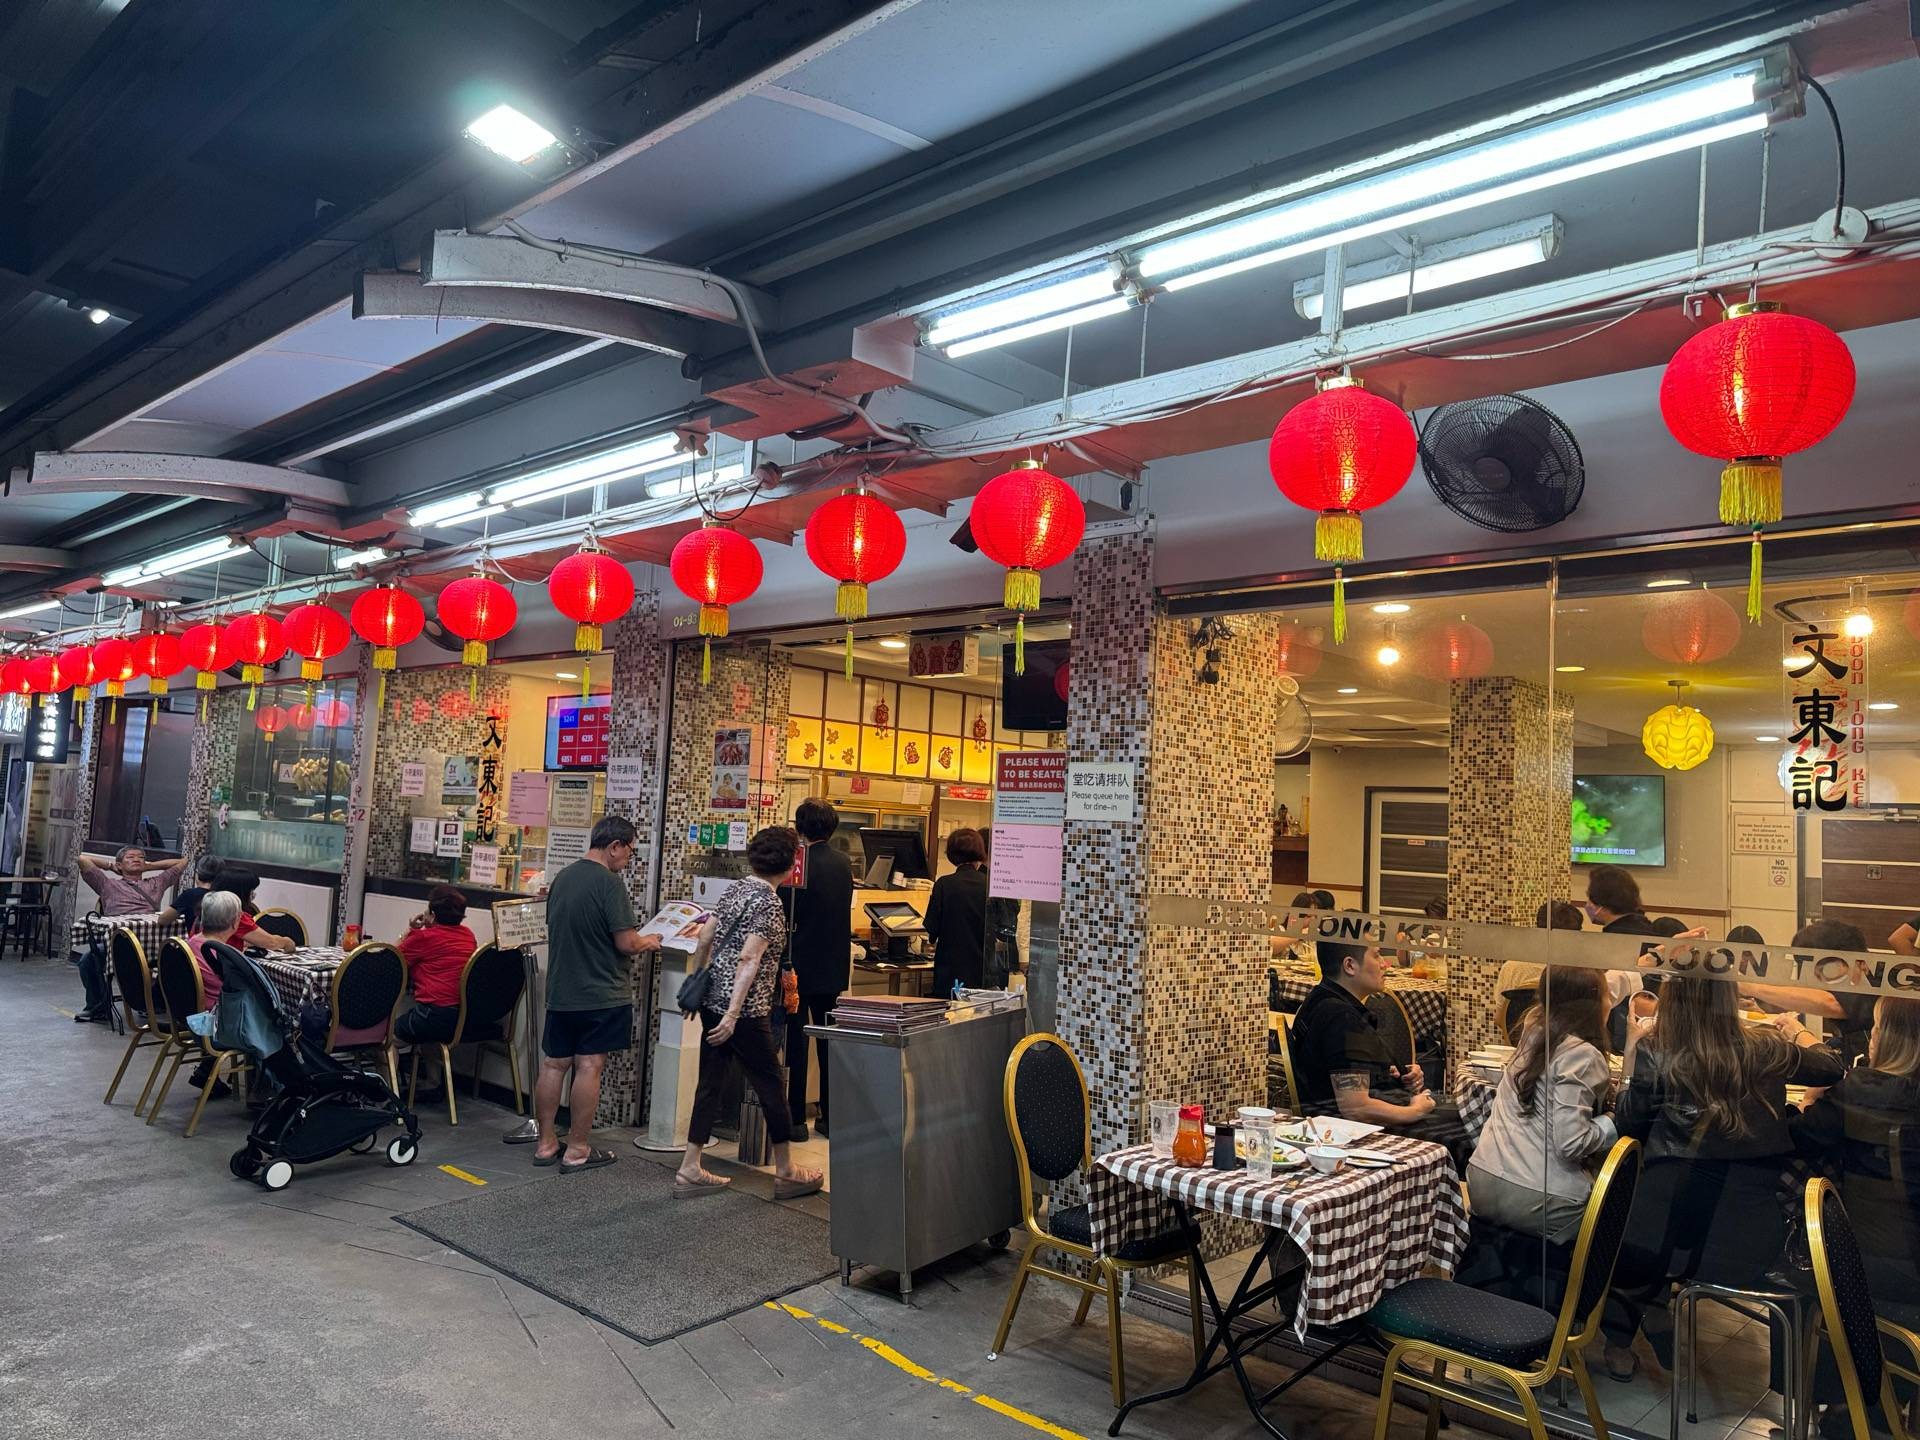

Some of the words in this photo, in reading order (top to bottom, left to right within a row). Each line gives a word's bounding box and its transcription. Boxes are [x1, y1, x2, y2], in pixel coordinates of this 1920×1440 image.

[673, 613, 697, 627] 01-93
[1788, 624, 1848, 812] 文東記
[1851, 699, 1864, 753] TONG
[1006, 758, 1040, 766] PLEASE
[1042, 758, 1065, 766] WAIT
[1004, 770, 1016, 778] TO
[1018, 770, 1030, 778] BE
[1073, 772, 1130, 788] 堂吃请排队
[1072, 792, 1092, 800] Please
[1114, 792, 1130, 800] here
[1852, 768, 1865, 809] KEE
[1084, 802, 1093, 810] for
[1291, 911, 1386, 942] TONG
[1638, 942, 1770, 978] BOON
[1785, 954, 1920, 991] TONG
